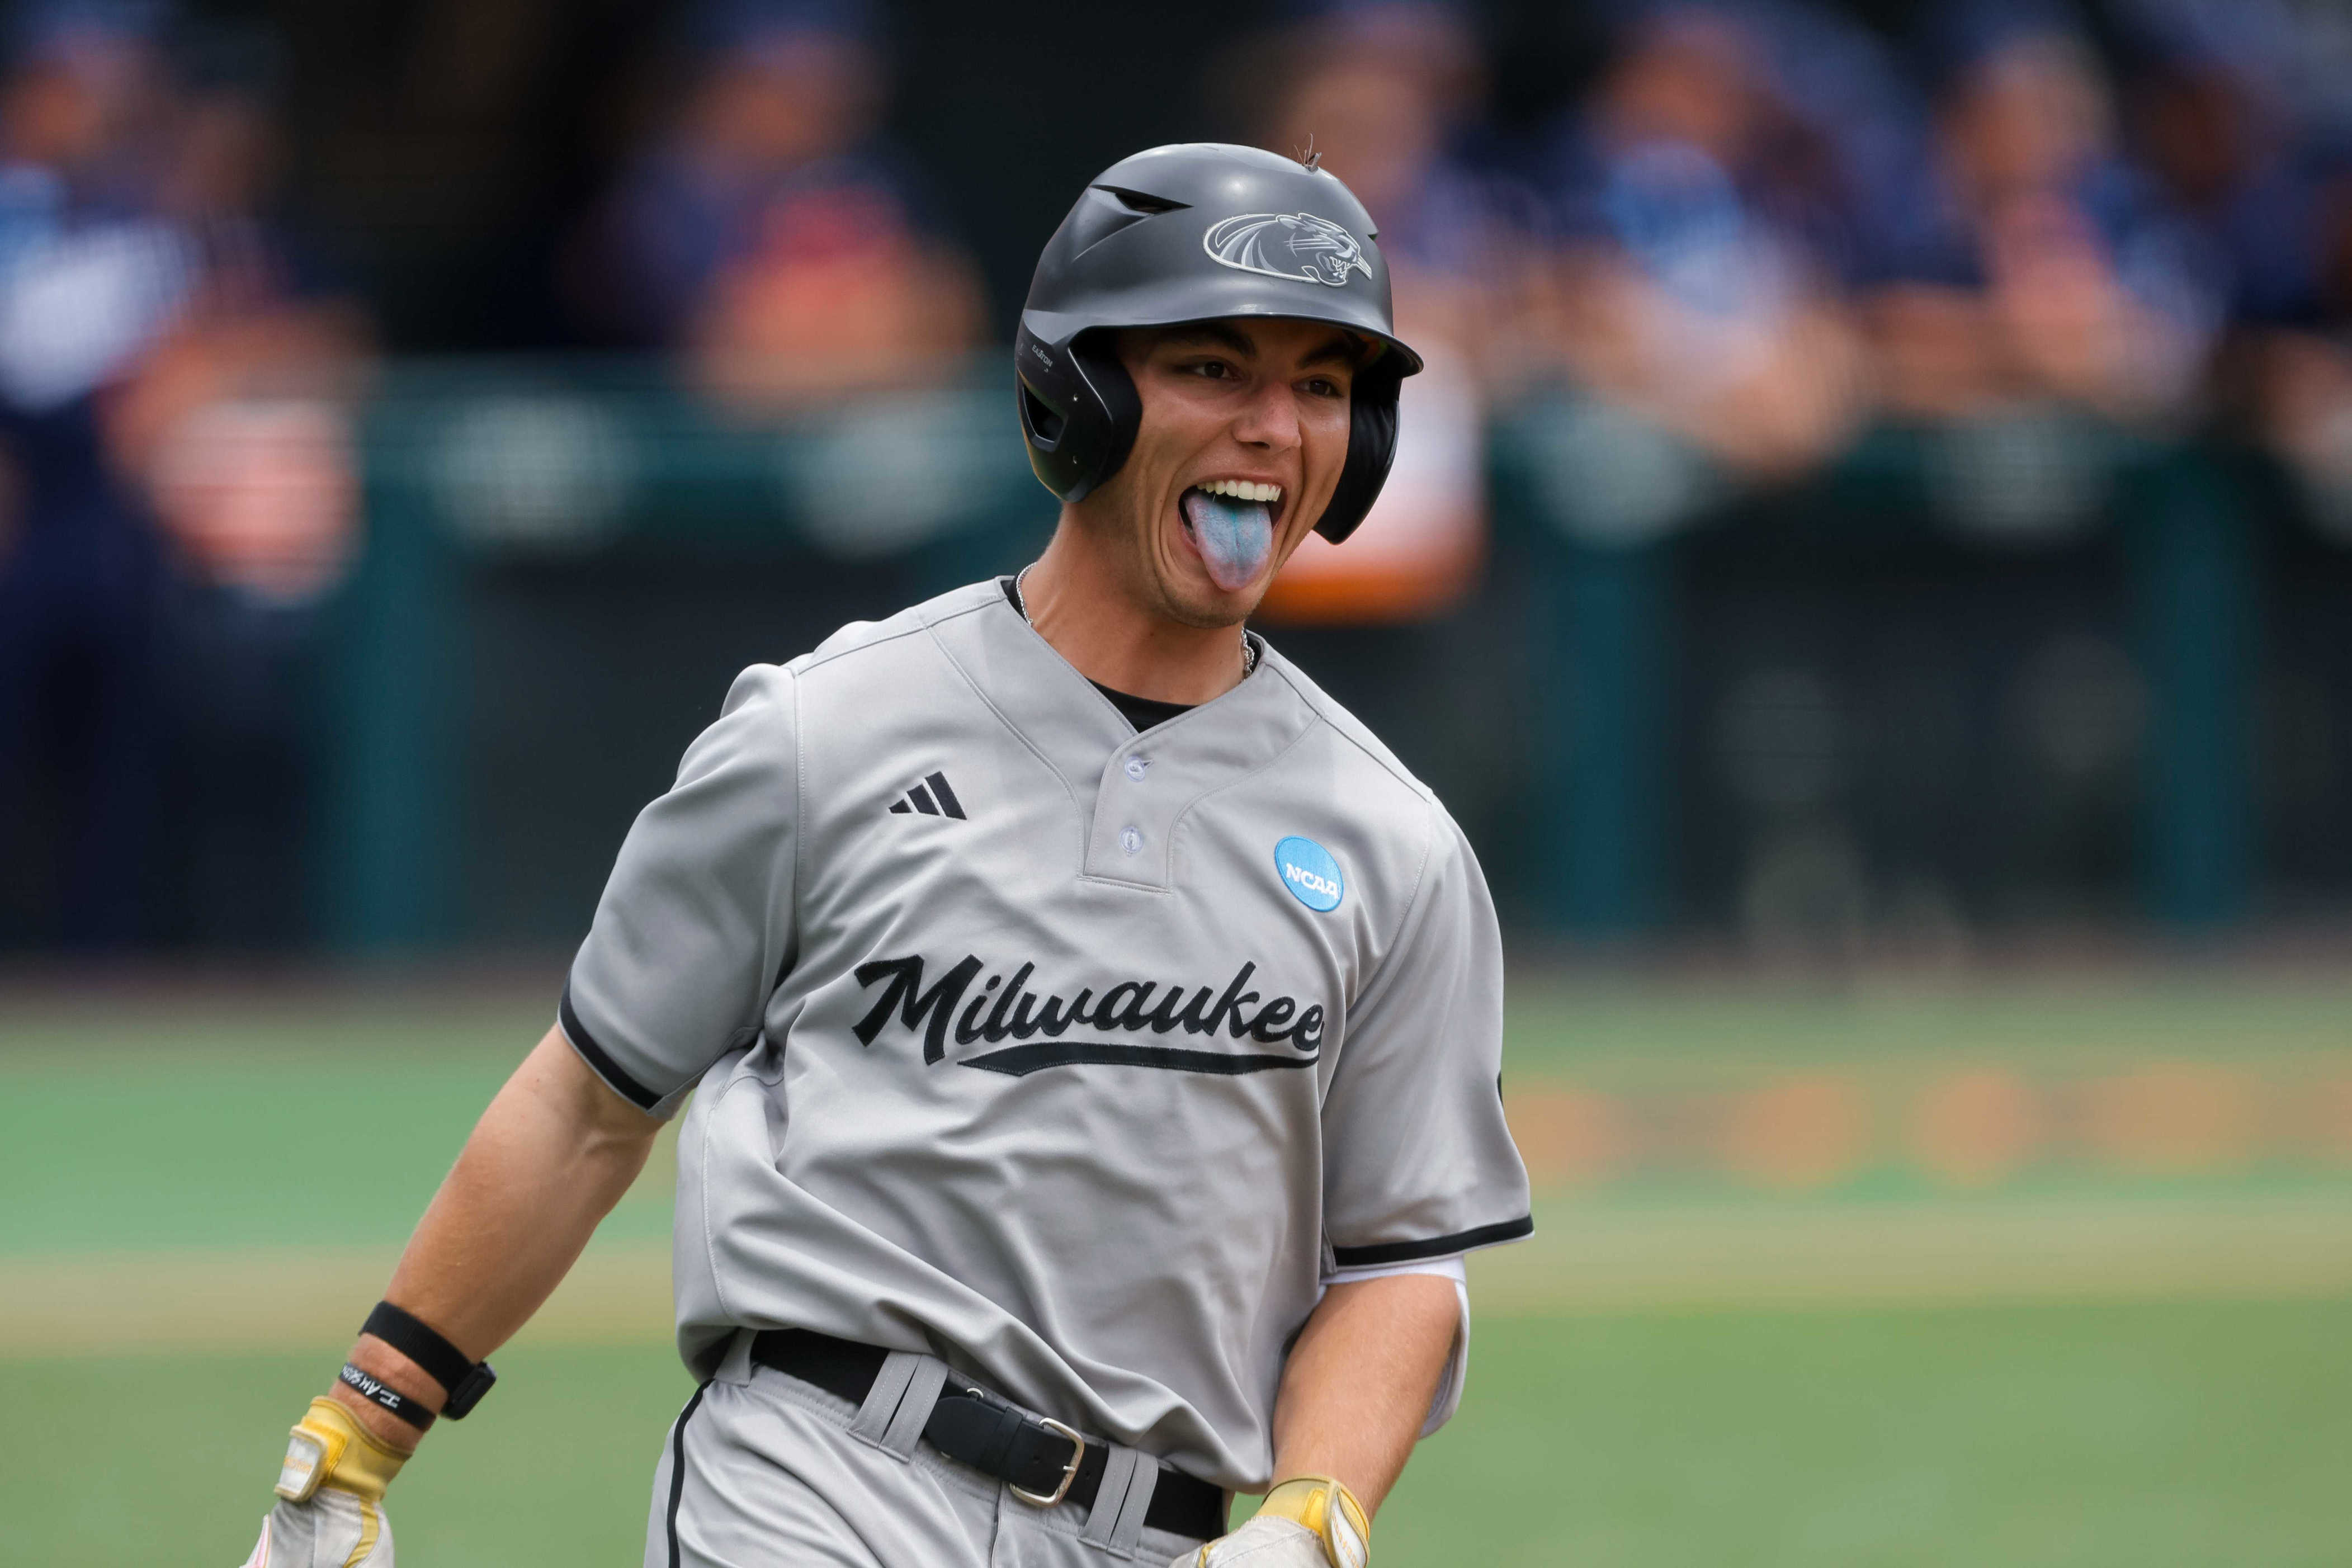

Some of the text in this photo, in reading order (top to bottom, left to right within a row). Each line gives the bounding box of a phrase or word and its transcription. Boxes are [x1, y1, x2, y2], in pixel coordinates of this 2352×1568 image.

[1032, 344, 1053, 367] EASTON
[1286, 863, 1339, 900] NCAA
[851, 954, 1324, 1065] Milwaukee
[358, 1376, 381, 1396] AM
[379, 1389, 401, 1408] I
